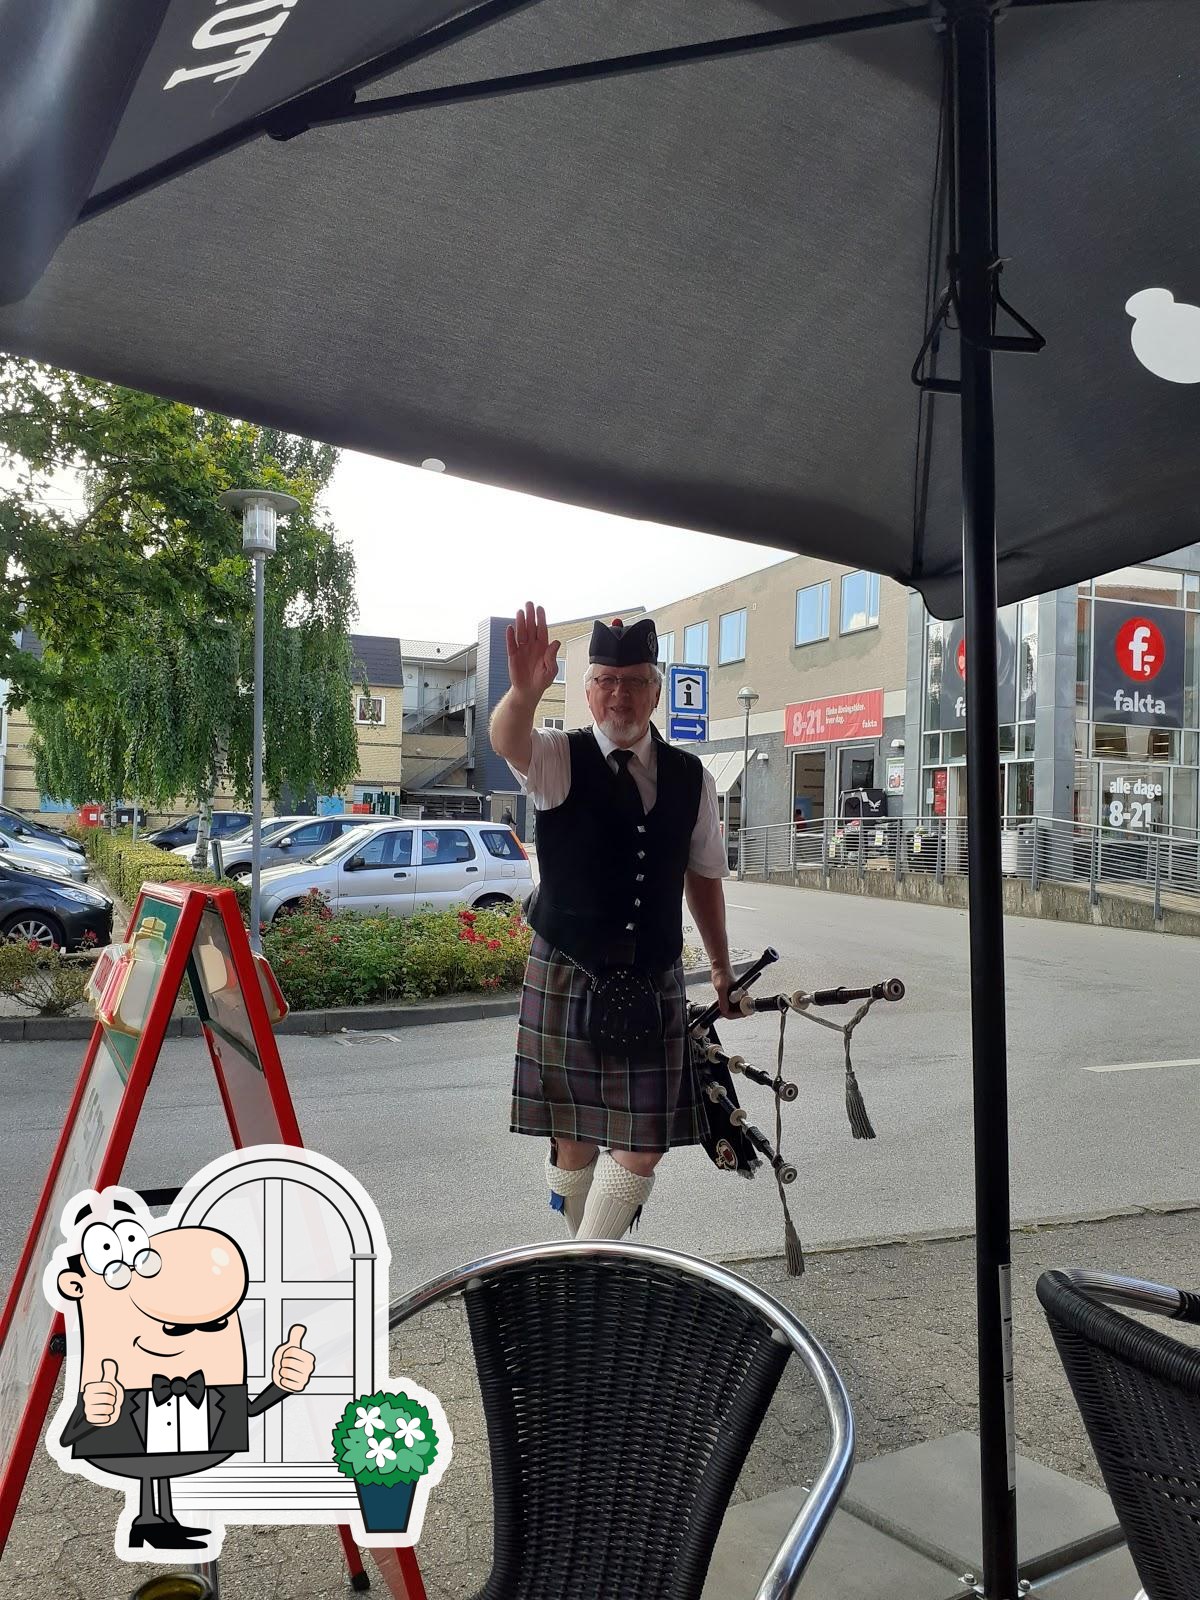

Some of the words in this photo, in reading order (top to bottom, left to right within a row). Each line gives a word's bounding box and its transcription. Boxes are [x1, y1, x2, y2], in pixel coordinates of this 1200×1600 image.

[1114, 689, 1166, 715] fakta
[862, 719, 878, 729] fakta
[1109, 777, 1131, 795] alle
[1133, 778, 1162, 800] dage
[1108, 800, 1152, 828] 8-21
